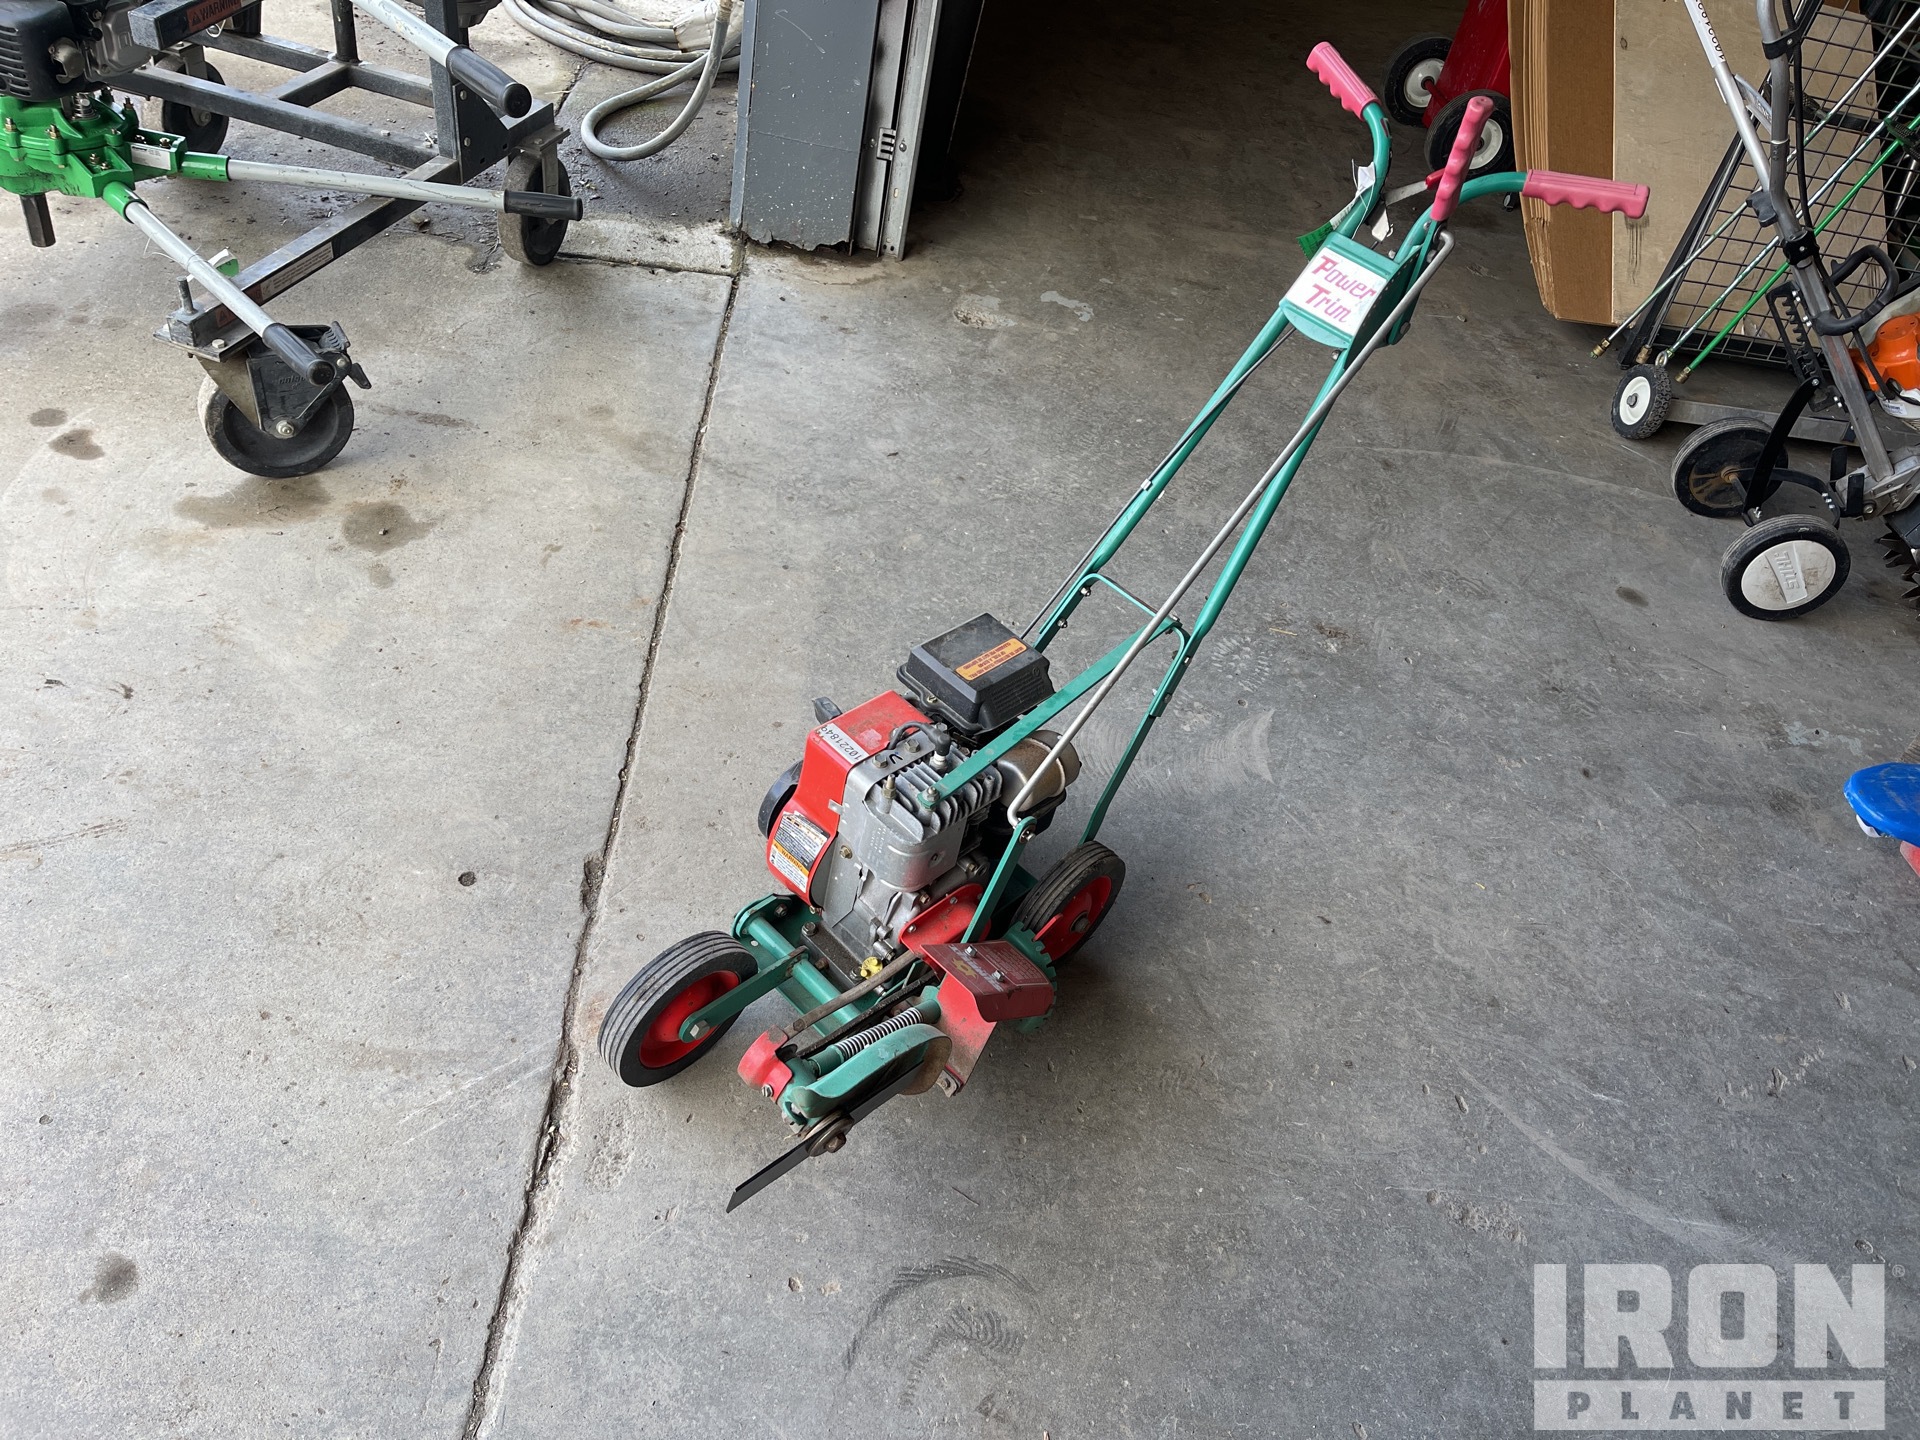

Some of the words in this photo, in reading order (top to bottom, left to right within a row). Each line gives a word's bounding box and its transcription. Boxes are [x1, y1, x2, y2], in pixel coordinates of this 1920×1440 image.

[1312, 255, 1377, 300] Power
[1305, 283, 1351, 323] Trim
[1775, 551, 1800, 590] STIHL
